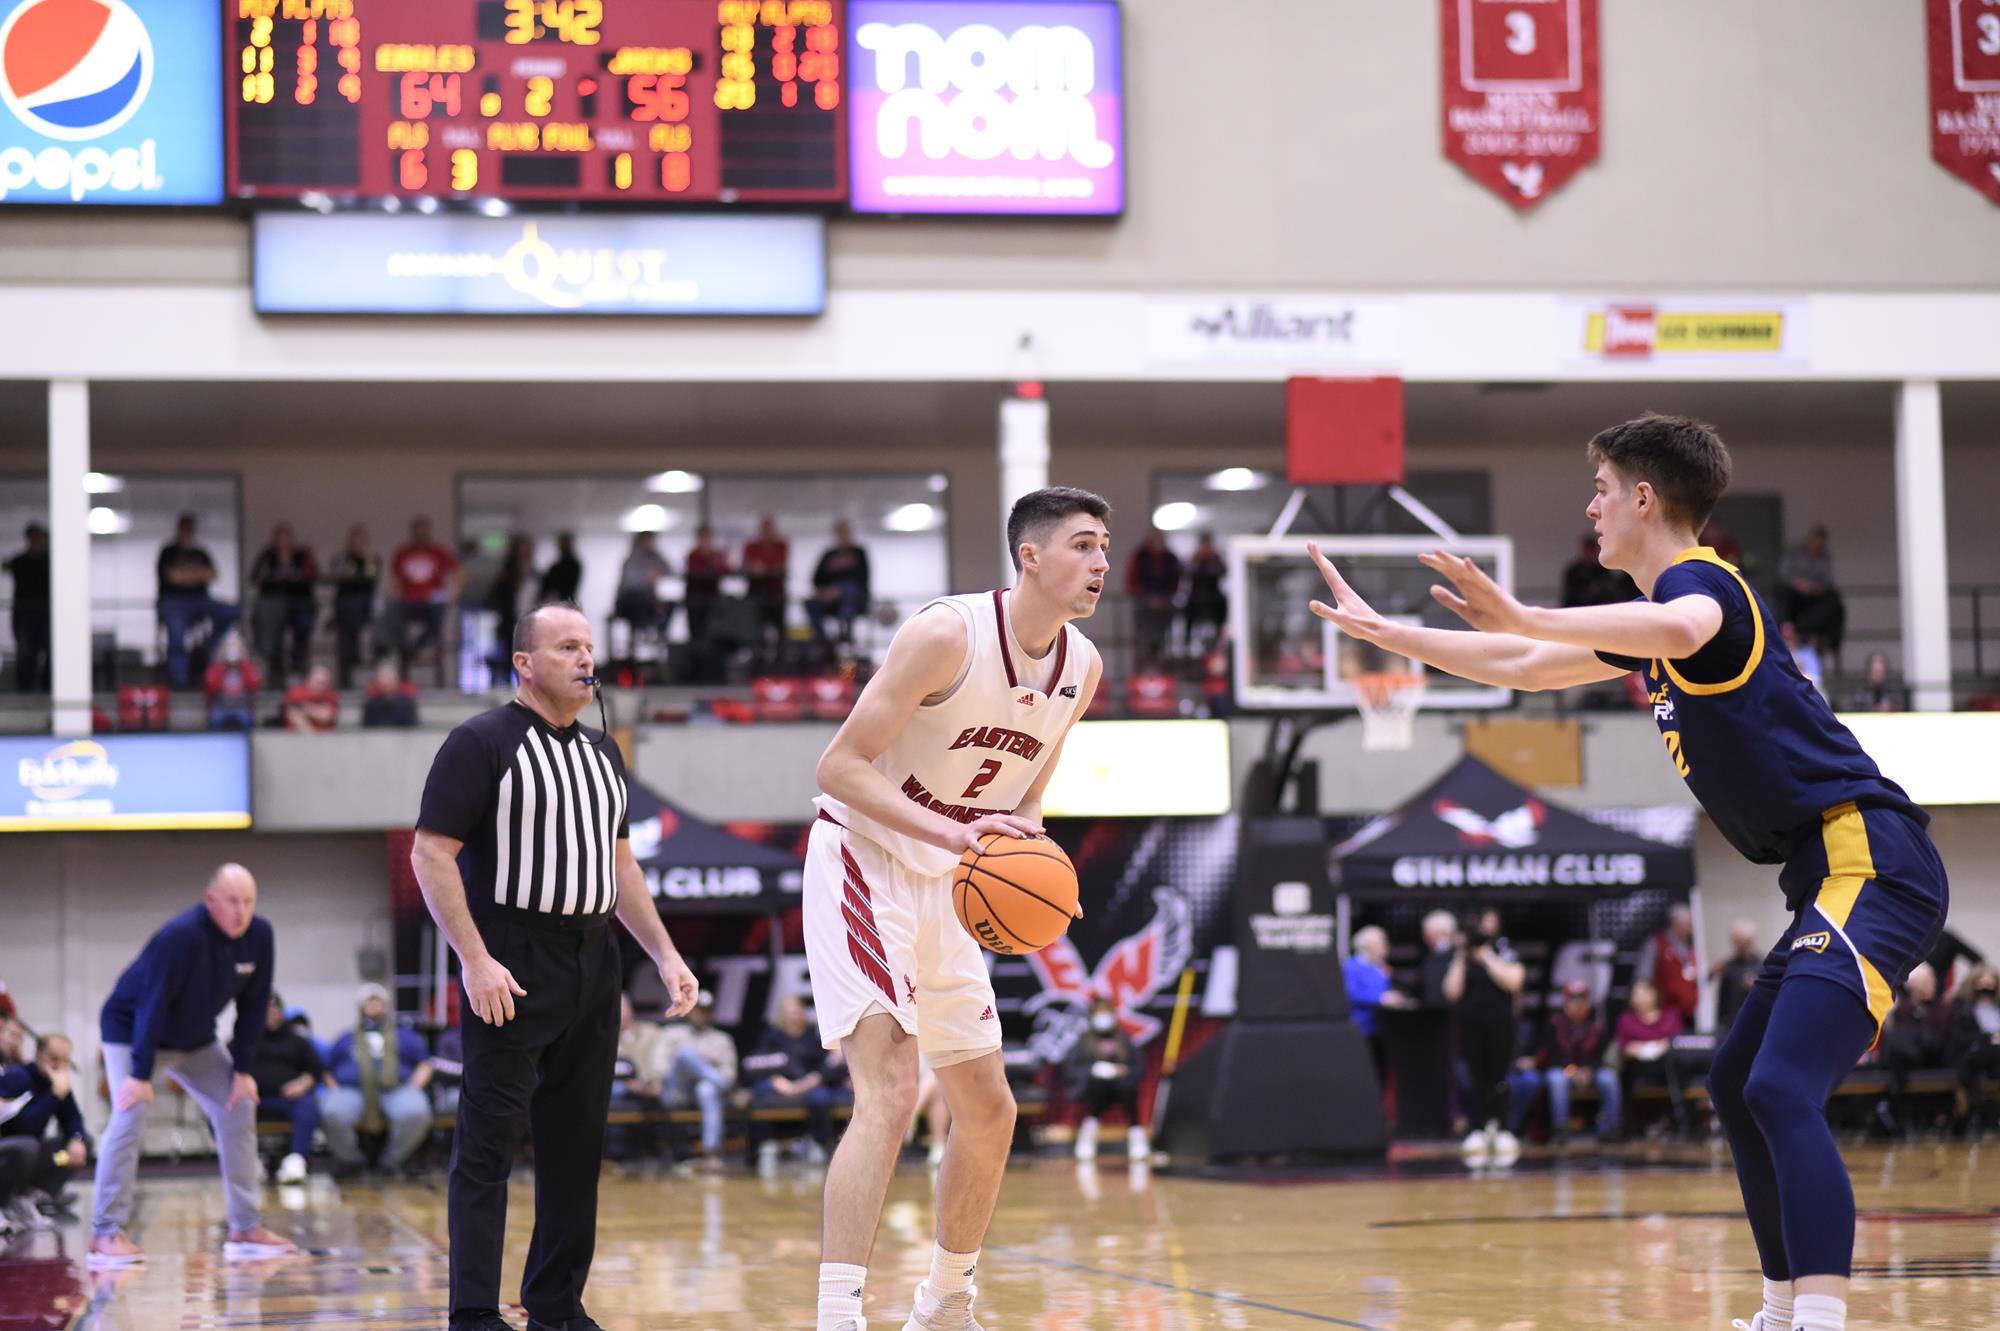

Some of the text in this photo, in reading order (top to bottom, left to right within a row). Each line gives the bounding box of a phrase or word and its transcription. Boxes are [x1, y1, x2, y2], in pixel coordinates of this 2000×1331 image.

[1504, 10, 1536, 55] 3
[400, 72, 461, 119] 64
[525, 76, 553, 117] 2
[627, 75, 690, 121] 56
[0, 138, 157, 200] pepsi
[400, 149, 428, 189] 6
[451, 148, 478, 191] 3
[960, 758, 1003, 798] 2
[662, 867, 763, 898] CLUB
[1467, 855, 1549, 886] MAN
[1553, 853, 1646, 885] CLUB
[975, 918, 1013, 954] Wil
